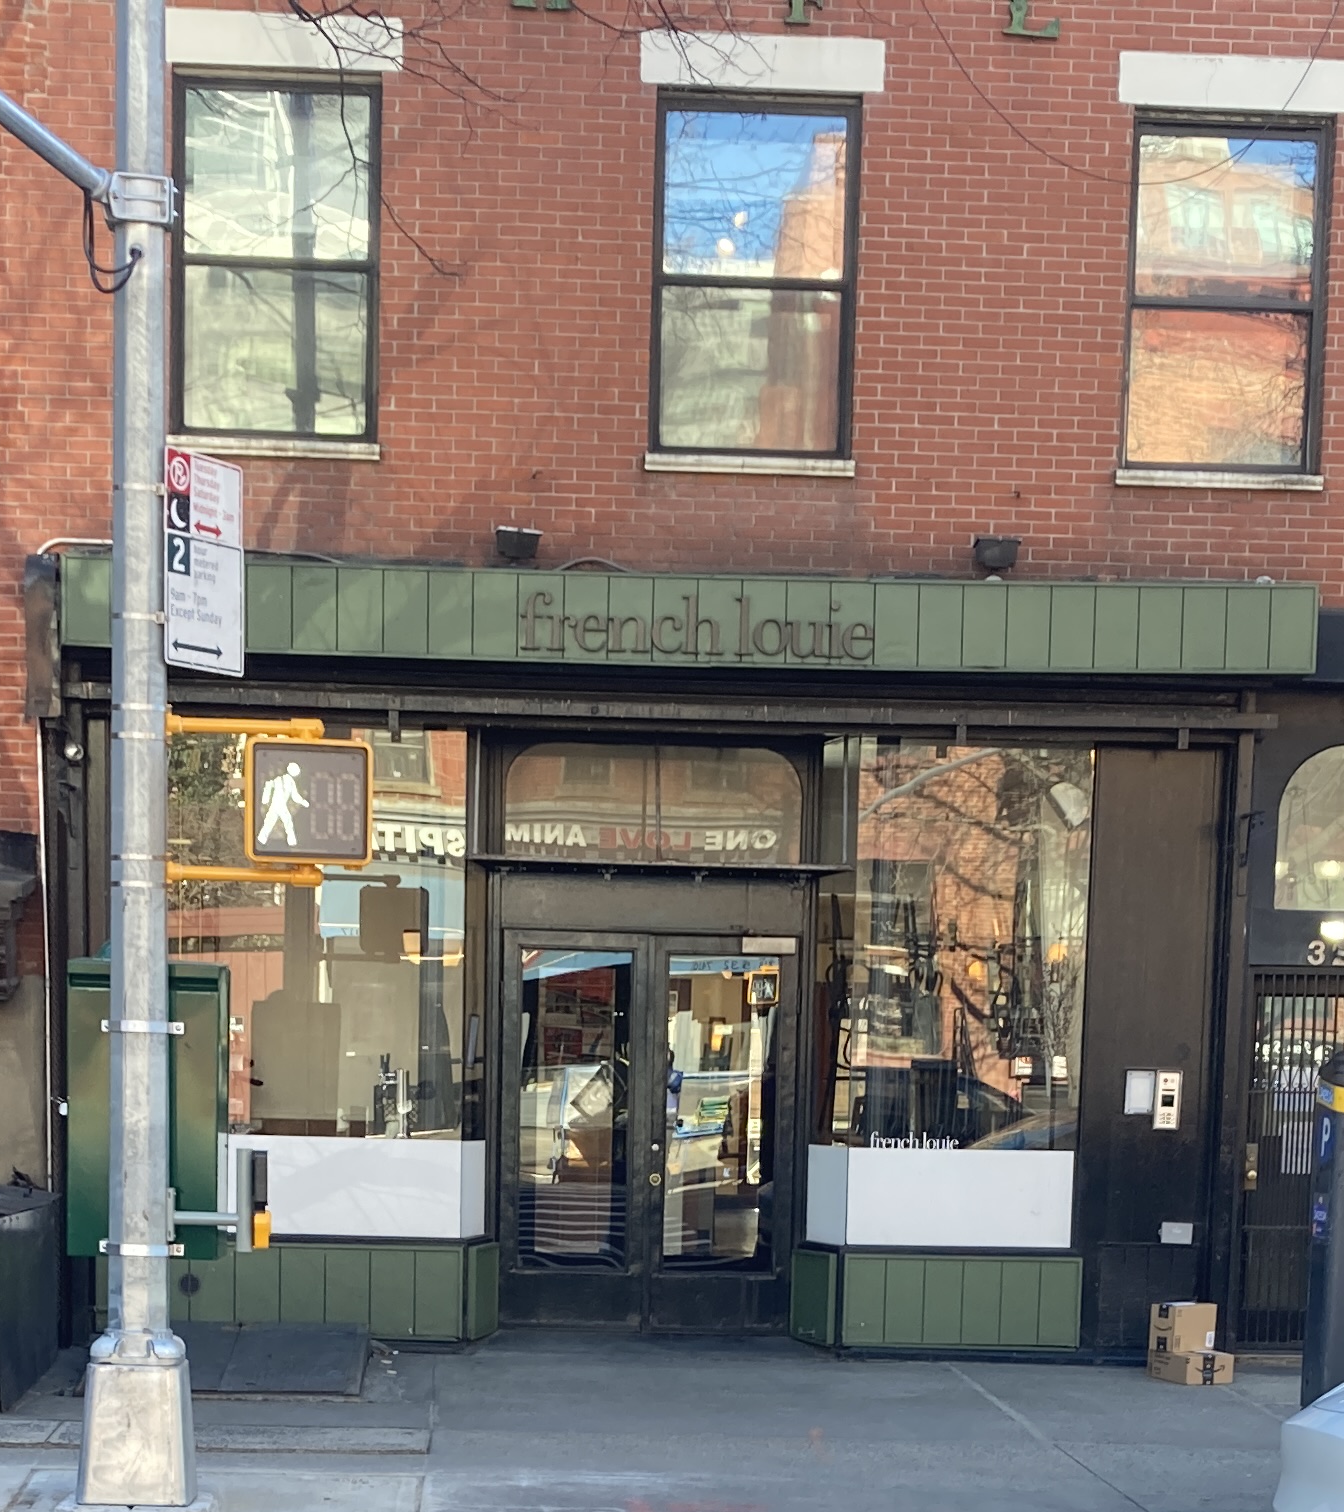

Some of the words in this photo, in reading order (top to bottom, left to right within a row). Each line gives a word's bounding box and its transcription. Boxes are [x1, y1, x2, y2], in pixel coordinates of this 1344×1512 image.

[172, 537, 186, 572] 2
[170, 603, 195, 620] Except
[197, 609, 223, 629] Sunday
[520, 592, 724, 657] french
[734, 597, 876, 661] louie
[870, 1131, 920, 1149] french
[922, 1131, 960, 1150] louie
